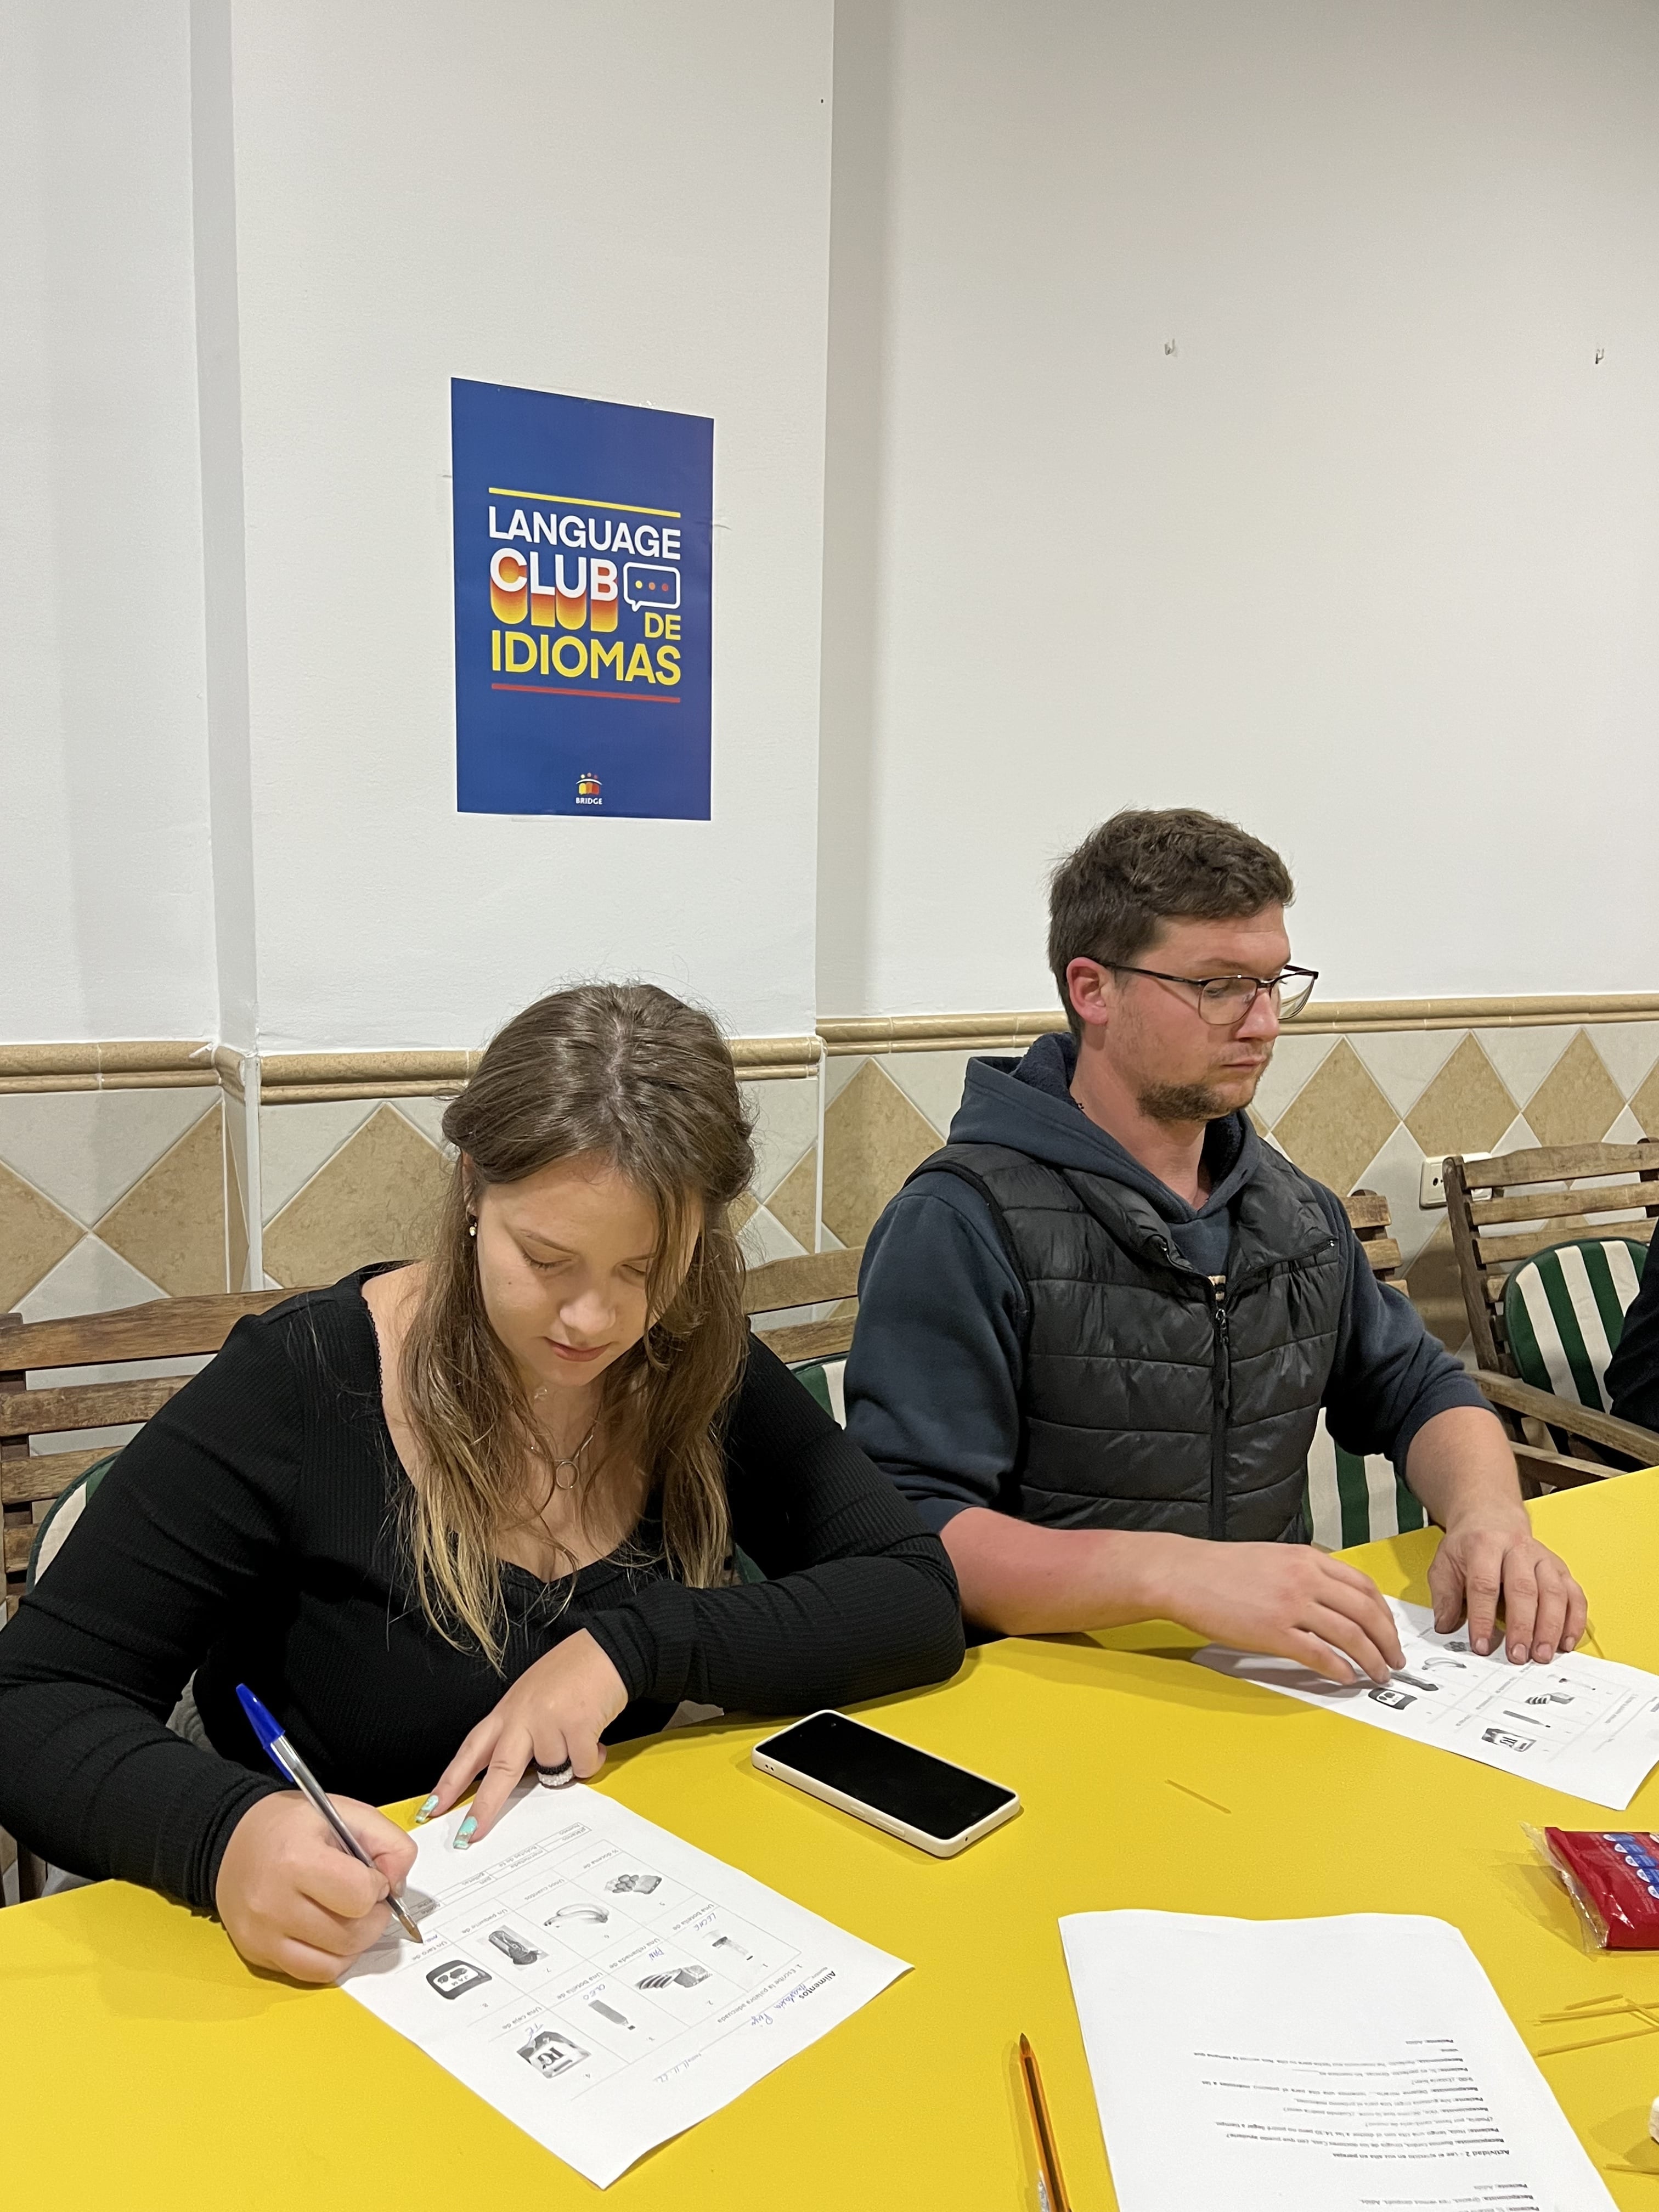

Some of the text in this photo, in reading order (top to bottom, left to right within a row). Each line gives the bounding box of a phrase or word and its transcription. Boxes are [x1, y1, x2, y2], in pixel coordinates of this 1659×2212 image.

[489, 506, 681, 560] LANGUAGE
[490, 547, 618, 606] CLUB
[645, 612, 681, 641] DE
[491, 629, 681, 686] IDIOMAS
[575, 797, 603, 805] BRIDGE
[546, 1877, 566, 1888] Unos
[679, 1911, 703, 1926] botella
[699, 1903, 715, 1913] Una
[689, 1912, 720, 1931] LECHE
[606, 1937, 661, 1970] Una rebanada de
[642, 1946, 667, 1961] PAN
[554, 1971, 605, 2001] Una botella de
[773, 1968, 798, 1985] Escribe
[796, 1970, 838, 2000] Alimentos
[744, 1987, 770, 2005] palabra
[500, 2005, 543, 2031] Una caja de
[715, 2003, 749, 2024] adecuada
[533, 2046, 567, 2067] PG
